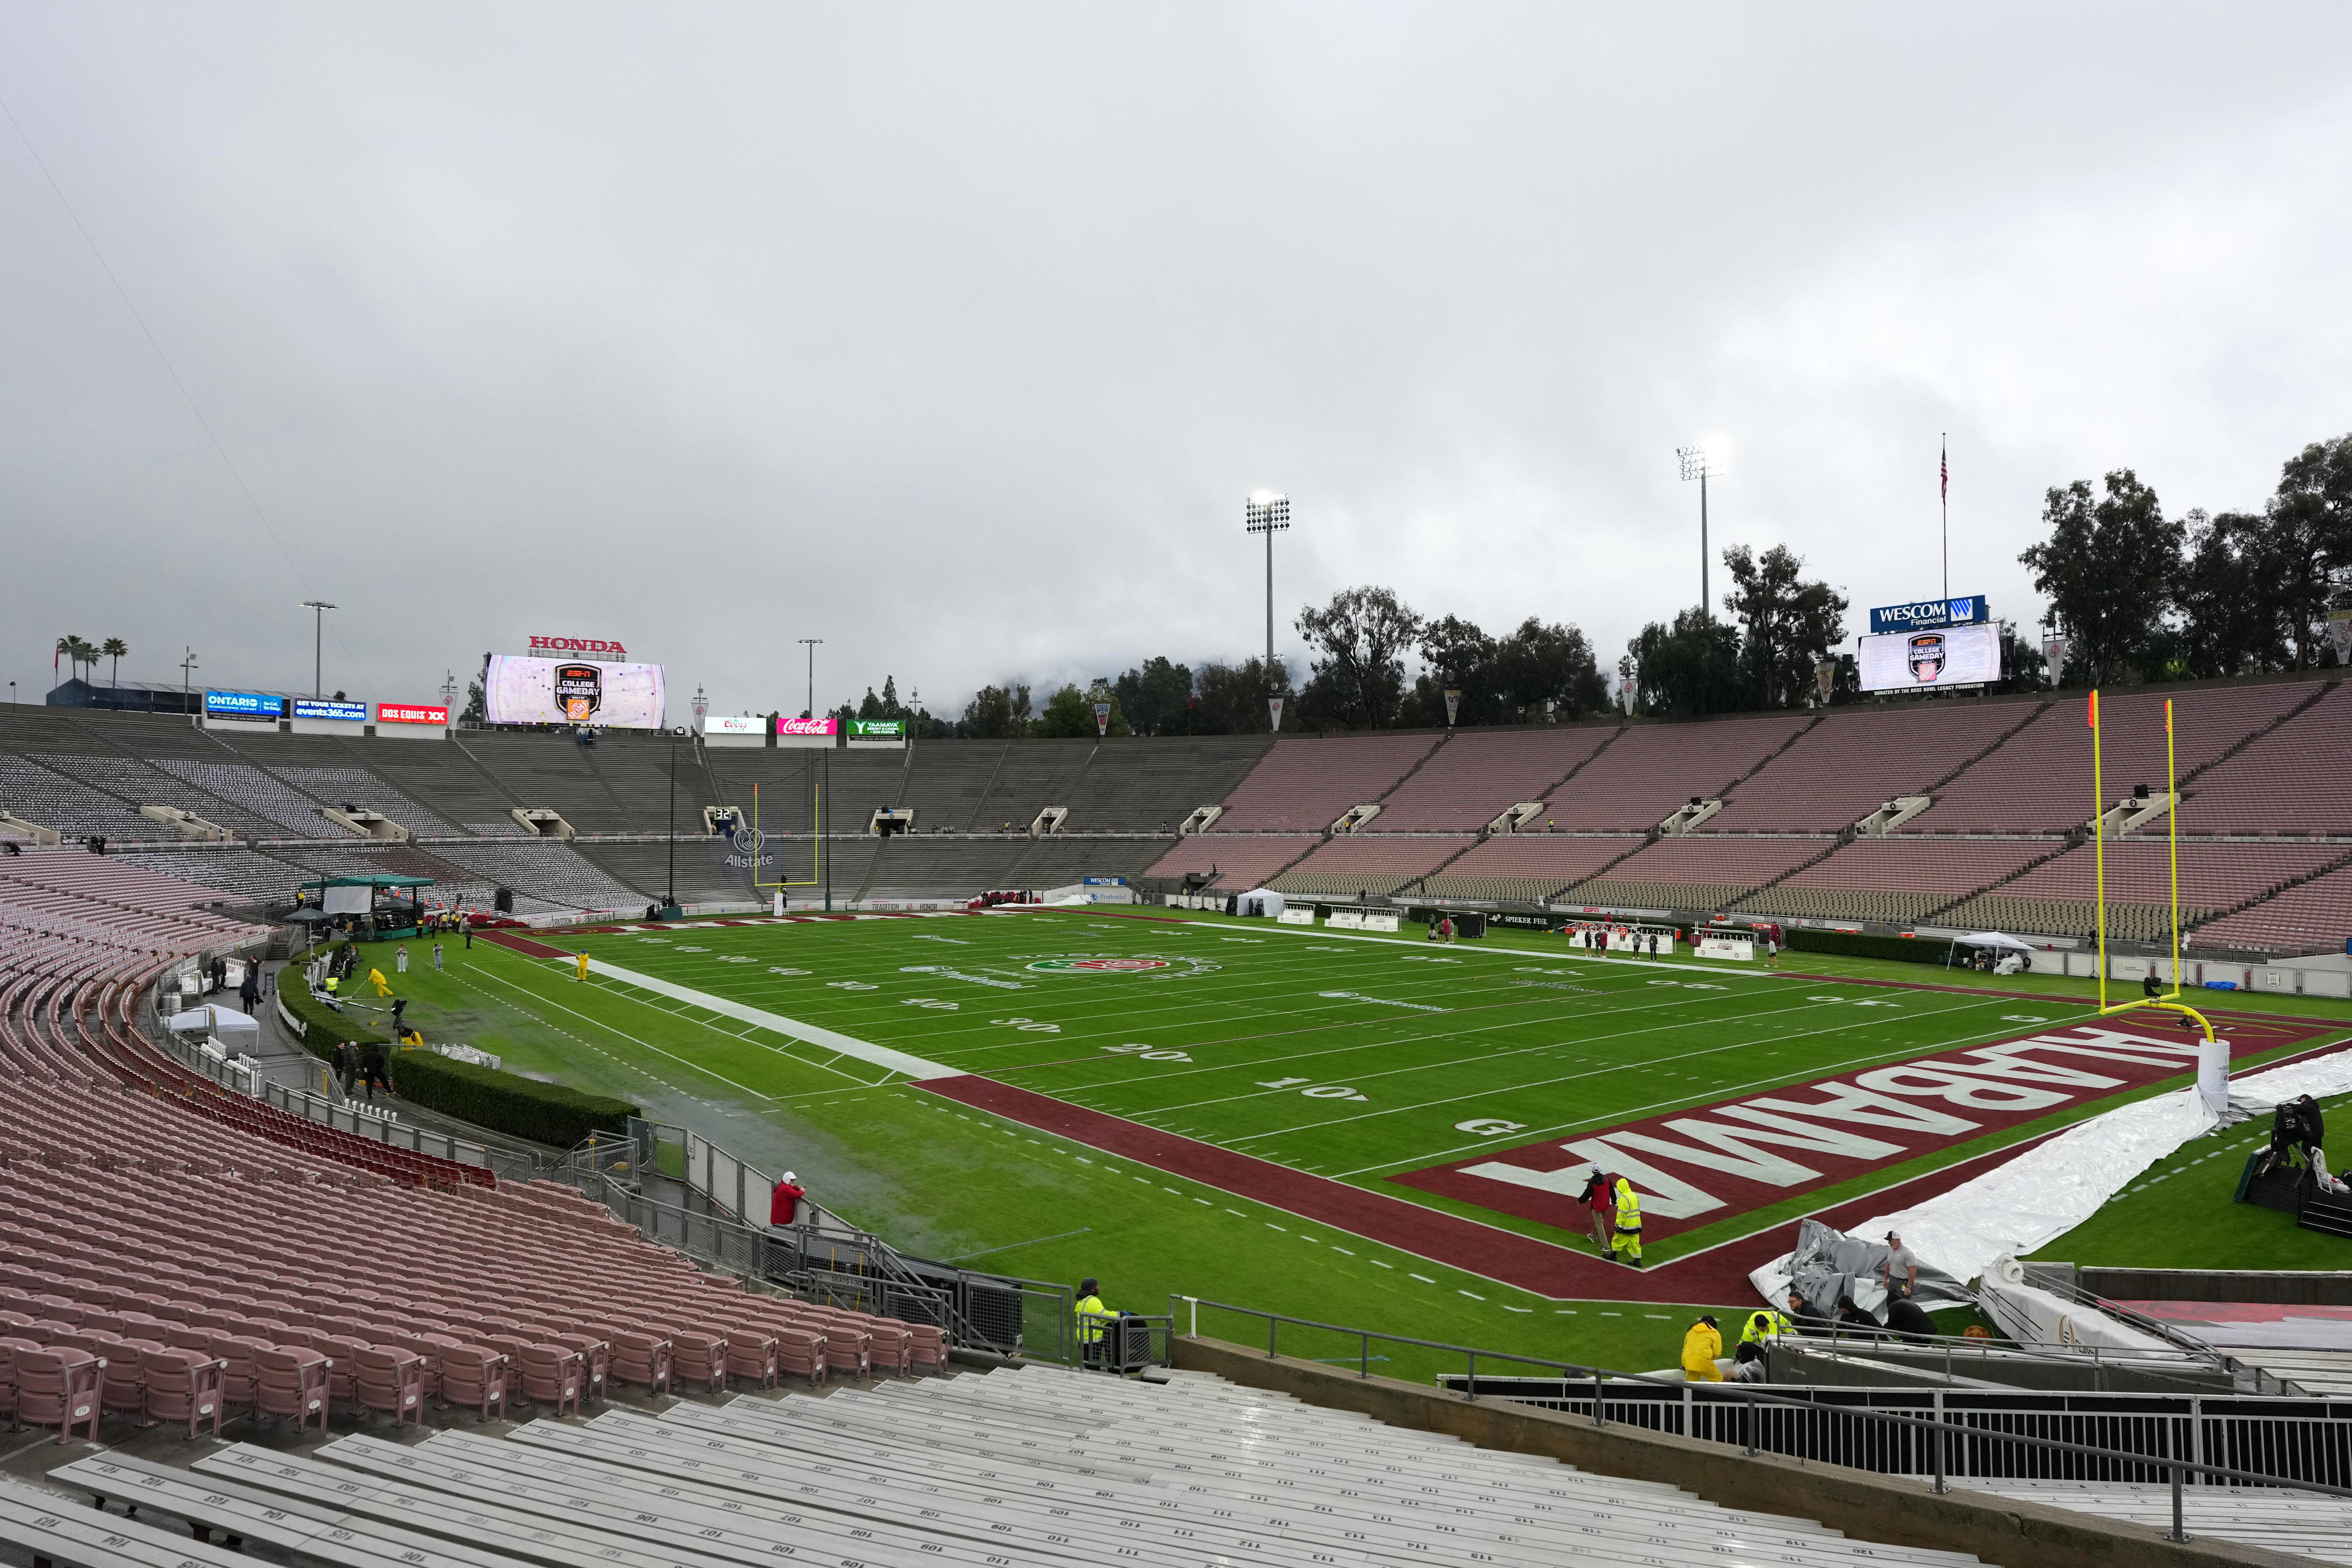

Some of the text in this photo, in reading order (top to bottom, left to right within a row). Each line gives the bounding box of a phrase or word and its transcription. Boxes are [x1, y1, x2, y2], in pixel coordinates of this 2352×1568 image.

[1879, 602, 1946, 622] WESCOM
[1911, 616, 1946, 626] Financial
[529, 636, 627, 653] HONDA
[1909, 651, 1944, 661] GAMEDAY
[556, 686, 600, 696] GAMEDAY
[208, 696, 258, 707] ONTARIO
[296, 708, 365, 718] events365.com
[382, 709, 399, 717] DOS
[428, 711, 445, 720] XX
[724, 719, 747, 728] Coors
[783, 719, 830, 734] Coca-Cola
[716, 809, 730, 819] 32
[724, 854, 773, 867] Allstate
[555, 917, 572, 926] PASSION
[611, 910, 1034, 932] INDIANA
[1764, 917, 1826, 928] TRADITION HONOR
[767, 967, 814, 975] 40
[826, 981, 880, 990] 50
[899, 998, 960, 1008] 40
[989, 1018, 1061, 1031] 30
[1099, 1043, 1188, 1062] 20
[1253, 1076, 1359, 1099] 10
[1454, 1117, 1531, 1136] G
[1456, 1026, 2200, 1220] ALABAMA
[832, 1276, 849, 1284] SEATS
[97, 1465, 120, 1473] 101
[140, 1477, 166, 1486] 102
[204, 1495, 229, 1505] 103
[1314, 1503, 1333, 1513] 112
[262, 1510, 287, 1520] 104
[32, 1517, 61, 1527] 103
[991, 1524, 1012, 1532] 109
[102, 1536, 131, 1547] 104
[1239, 1540, 1260, 1549] 112
[1407, 1541, 1428, 1550] 114
[771, 1545, 796, 1555] 108
[920, 1544, 943, 1552] 109
[1117, 1546, 1139, 1556] 111
[400, 1552, 427, 1562] 106
[986, 1556, 1009, 1566] 110
[1312, 1554, 1335, 1562] 113
